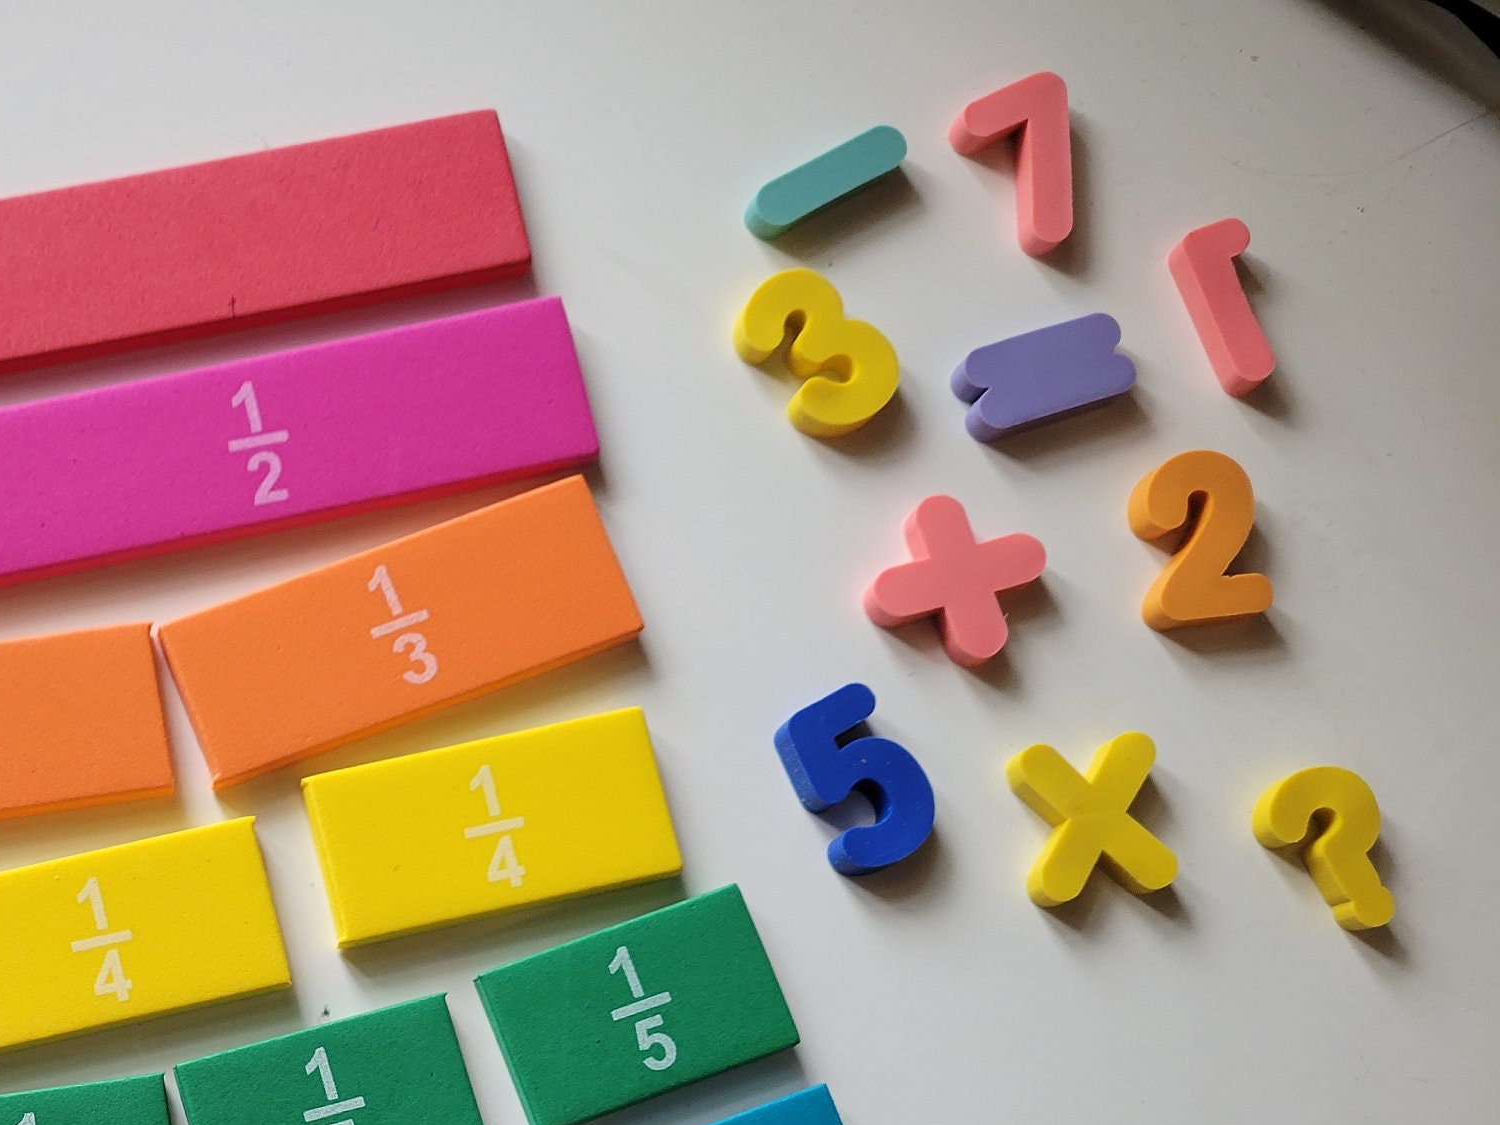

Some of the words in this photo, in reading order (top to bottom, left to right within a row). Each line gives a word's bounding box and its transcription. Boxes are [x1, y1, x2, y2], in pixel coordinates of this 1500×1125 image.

[949, 71, 1073, 258] 7
[733, 268, 899, 437] 3
[231, 381, 262, 433] 1
[247, 450, 289, 506] 2
[1127, 450, 1273, 631] 2
[367, 564, 404, 617] 1
[392, 632, 439, 685] 3
[469, 764, 502, 818] 1
[773, 682, 935, 877] 5
[486, 834, 527, 888] 4
[76, 876, 109, 932] 1
[93, 947, 133, 1003] 4
[607, 945, 645, 999] 1
[634, 1013, 678, 1071] 5
[304, 1046, 339, 1101] 1
